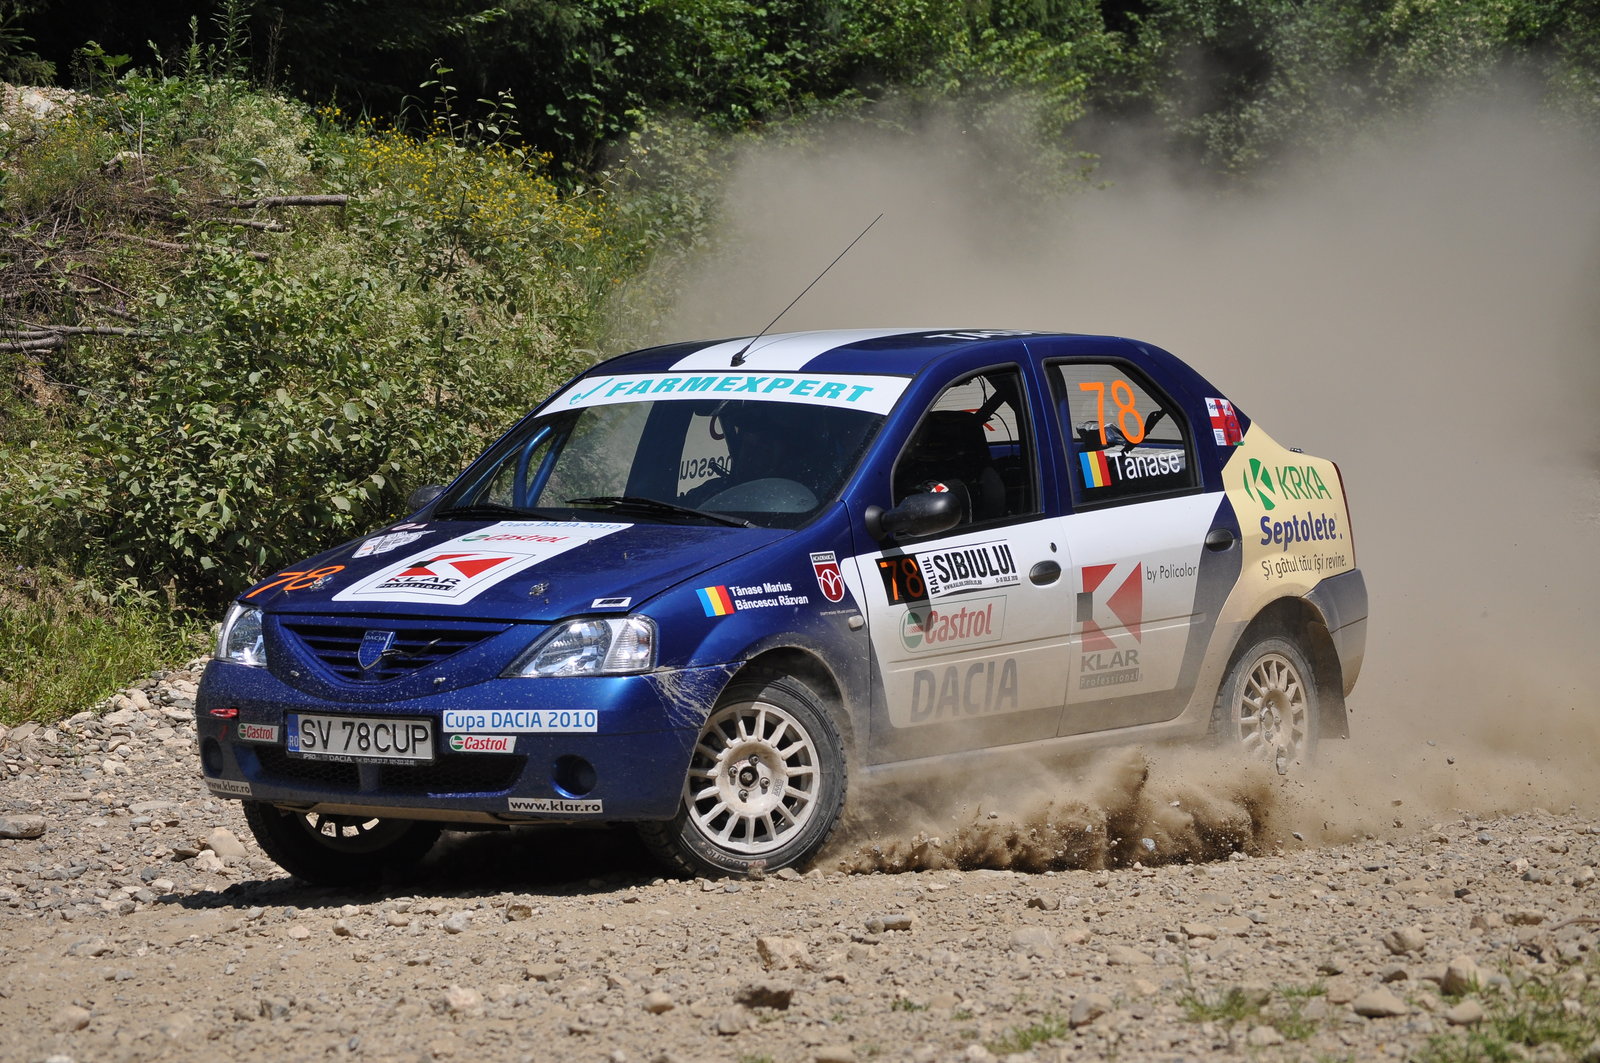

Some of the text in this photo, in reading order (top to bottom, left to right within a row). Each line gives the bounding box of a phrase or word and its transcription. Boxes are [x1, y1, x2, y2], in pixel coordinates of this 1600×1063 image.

[606, 376, 875, 402] FARMEXPERT
[1079, 380, 1145, 445] 78
[1110, 451, 1180, 481] Tănase
[1276, 465, 1332, 500] KRKA
[484, 534, 570, 543] Castrol
[933, 544, 1017, 584] SIBIULUI
[1146, 562, 1198, 583] by Policolor
[385, 576, 462, 586] KLAR
[879, 558, 924, 601] 78
[922, 556, 941, 595] RALIUL
[729, 582, 793, 597] Tănase Marius
[735, 594, 809, 611] Băncescu Răzvan
[925, 603, 993, 644] Castrol
[1080, 649, 1139, 673] KLAR
[1080, 669, 1138, 689] Professional
[910, 658, 1019, 723] DACIA
[246, 725, 274, 741] Castrol
[445, 712, 596, 732] Cupa DACIA 2010
[289, 735, 299, 747] RO
[300, 719, 333, 750] SV
[464, 736, 508, 751] Castrol
[510, 801, 601, 812] www.klar.ro
